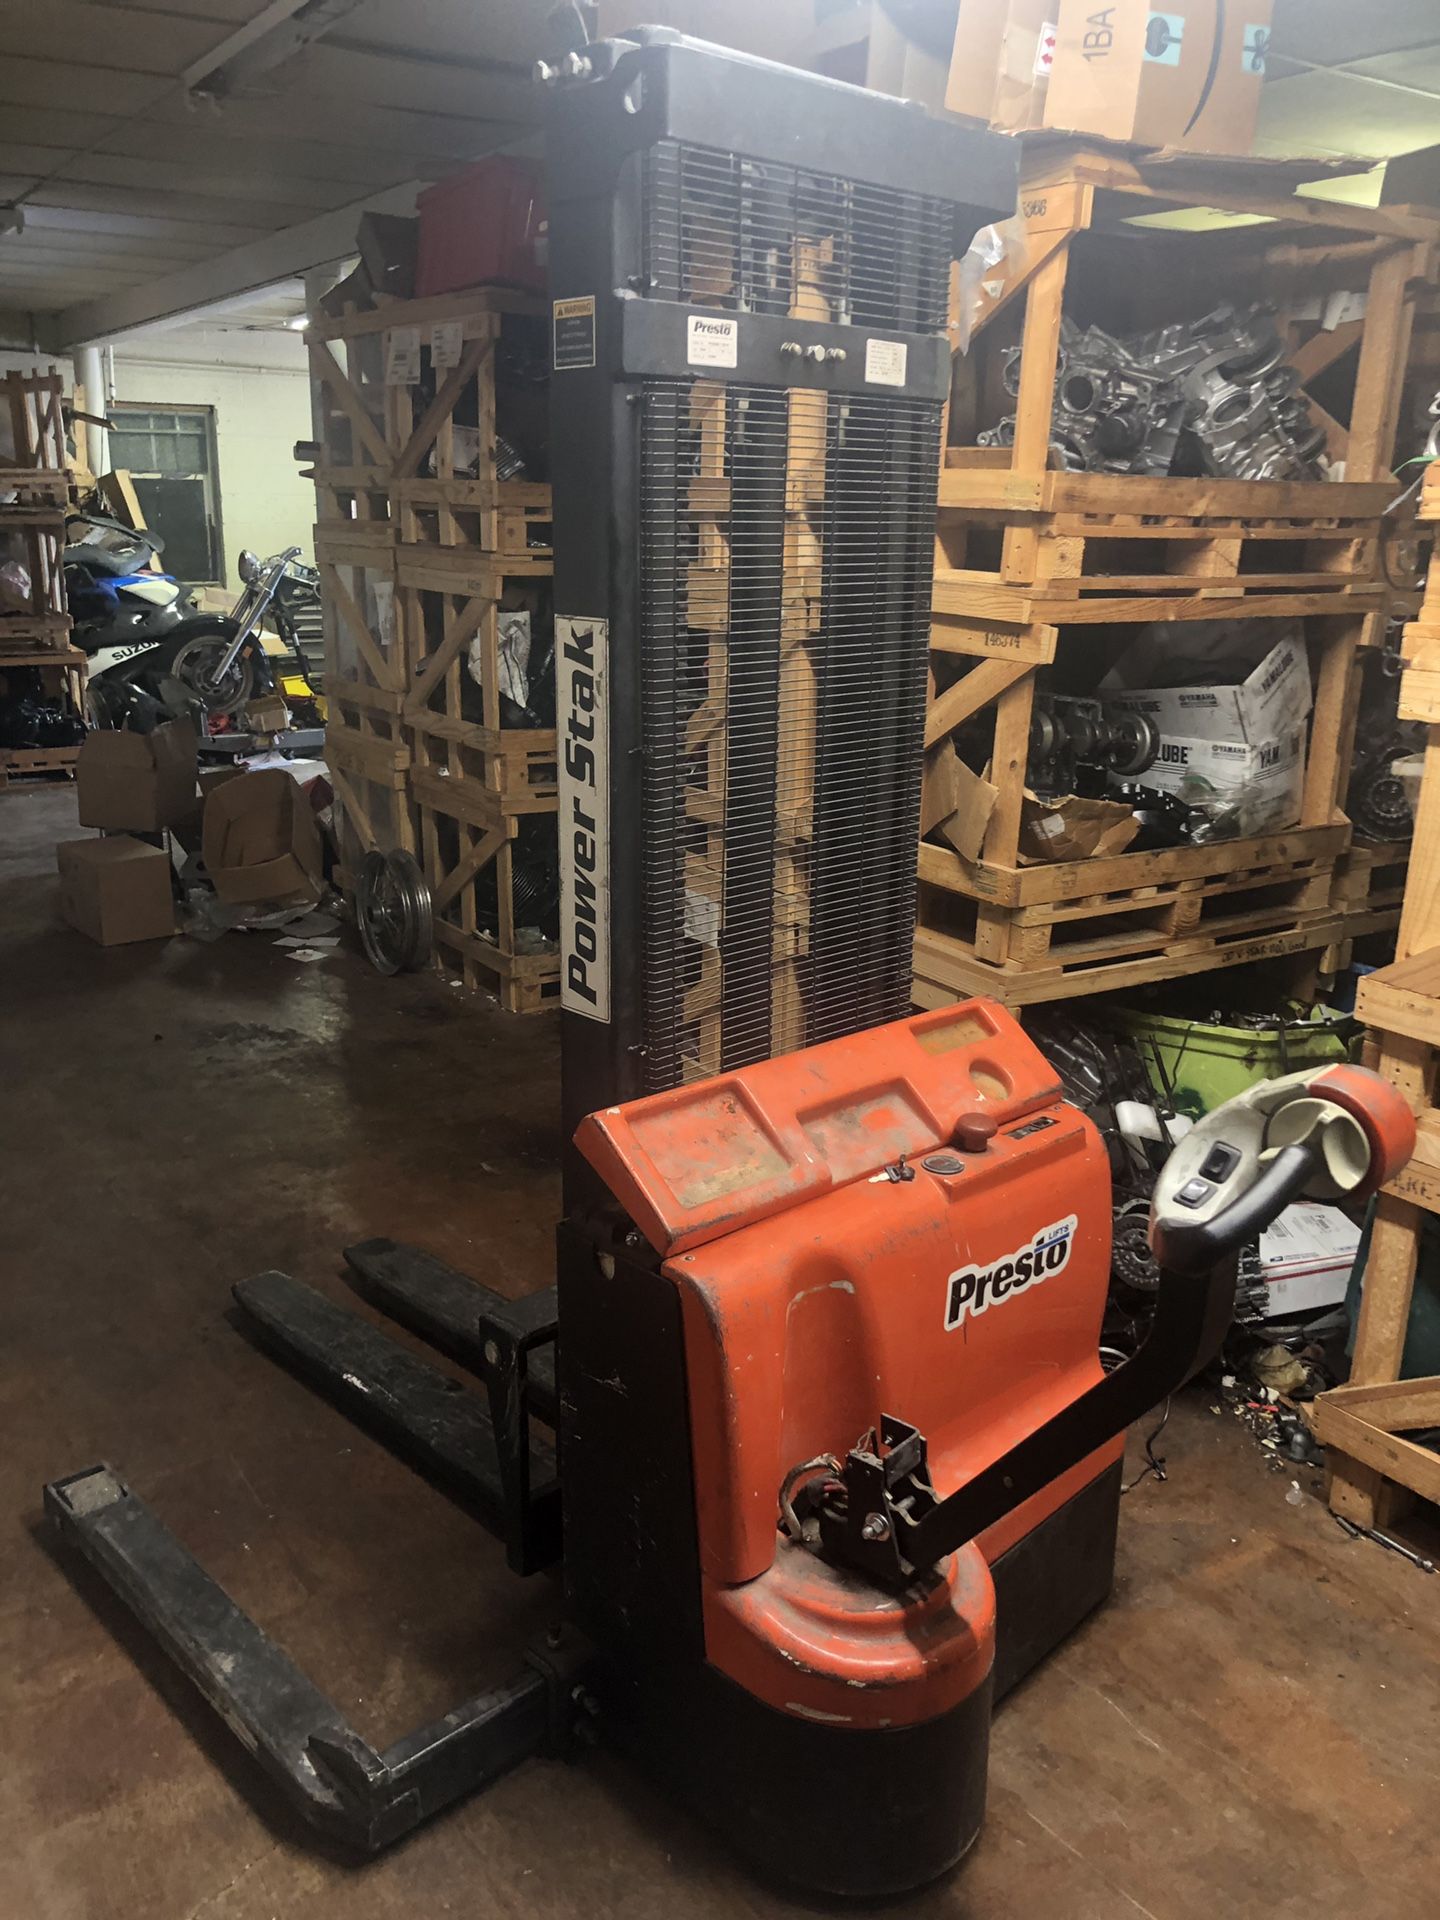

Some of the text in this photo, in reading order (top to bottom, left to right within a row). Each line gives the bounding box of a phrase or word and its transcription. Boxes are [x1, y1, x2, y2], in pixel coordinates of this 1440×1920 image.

[1082, 7, 1116, 62] 1BA
[694, 321, 731, 335] Presto
[563, 623, 597, 1006] Power Stak
[1048, 1224, 1070, 1240] LIFTS
[948, 1236, 1067, 1324] Presto
